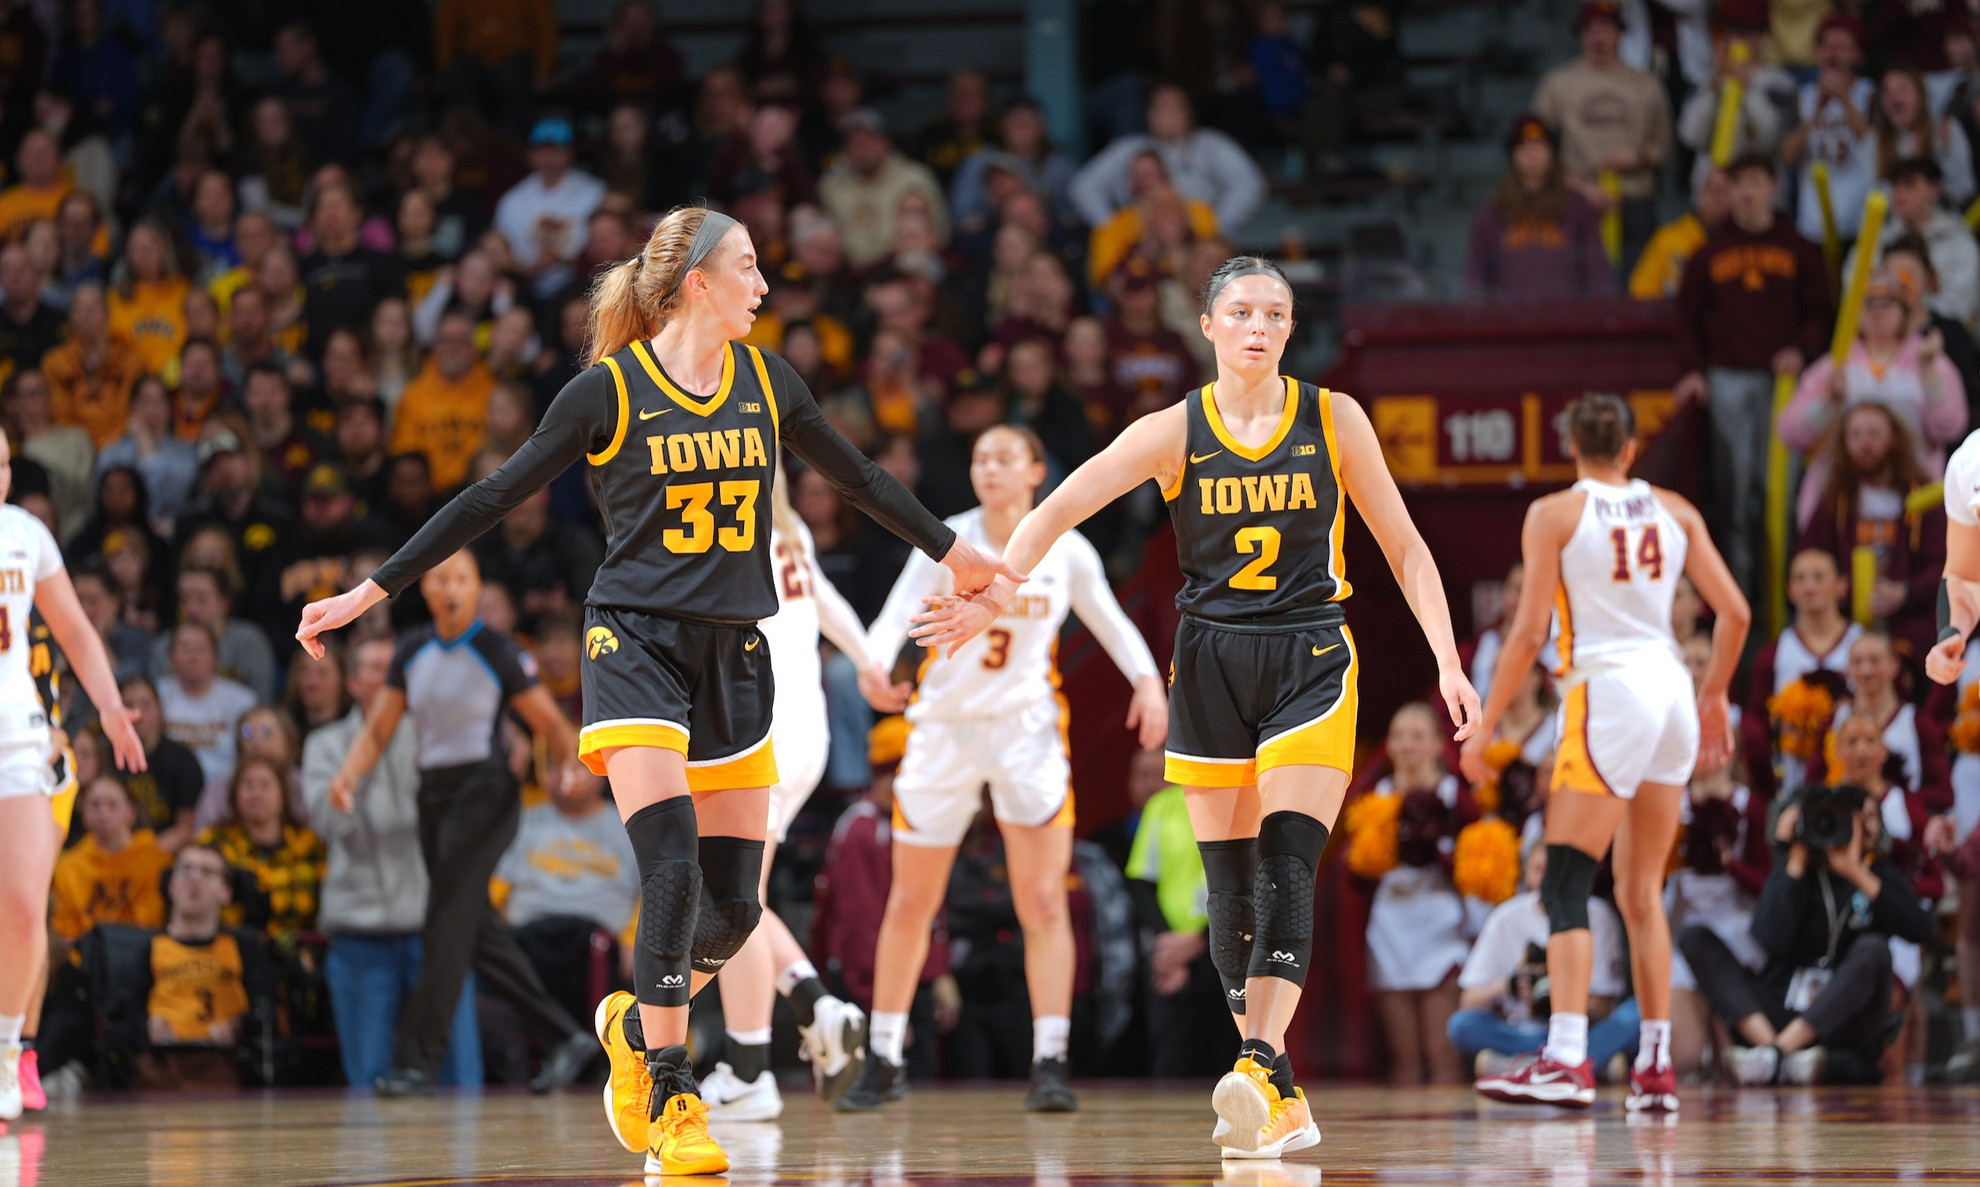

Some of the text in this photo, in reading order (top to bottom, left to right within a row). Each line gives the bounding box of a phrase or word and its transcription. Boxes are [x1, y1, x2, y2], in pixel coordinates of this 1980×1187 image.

[647, 428, 767, 475] IOWA
[1444, 409, 1516, 461] 110
[663, 480, 760, 554] 33
[1199, 473, 1316, 515] IOWA
[1229, 526, 1281, 591] 2
[1611, 524, 1663, 581] 14
[981, 627, 1013, 672] 3
